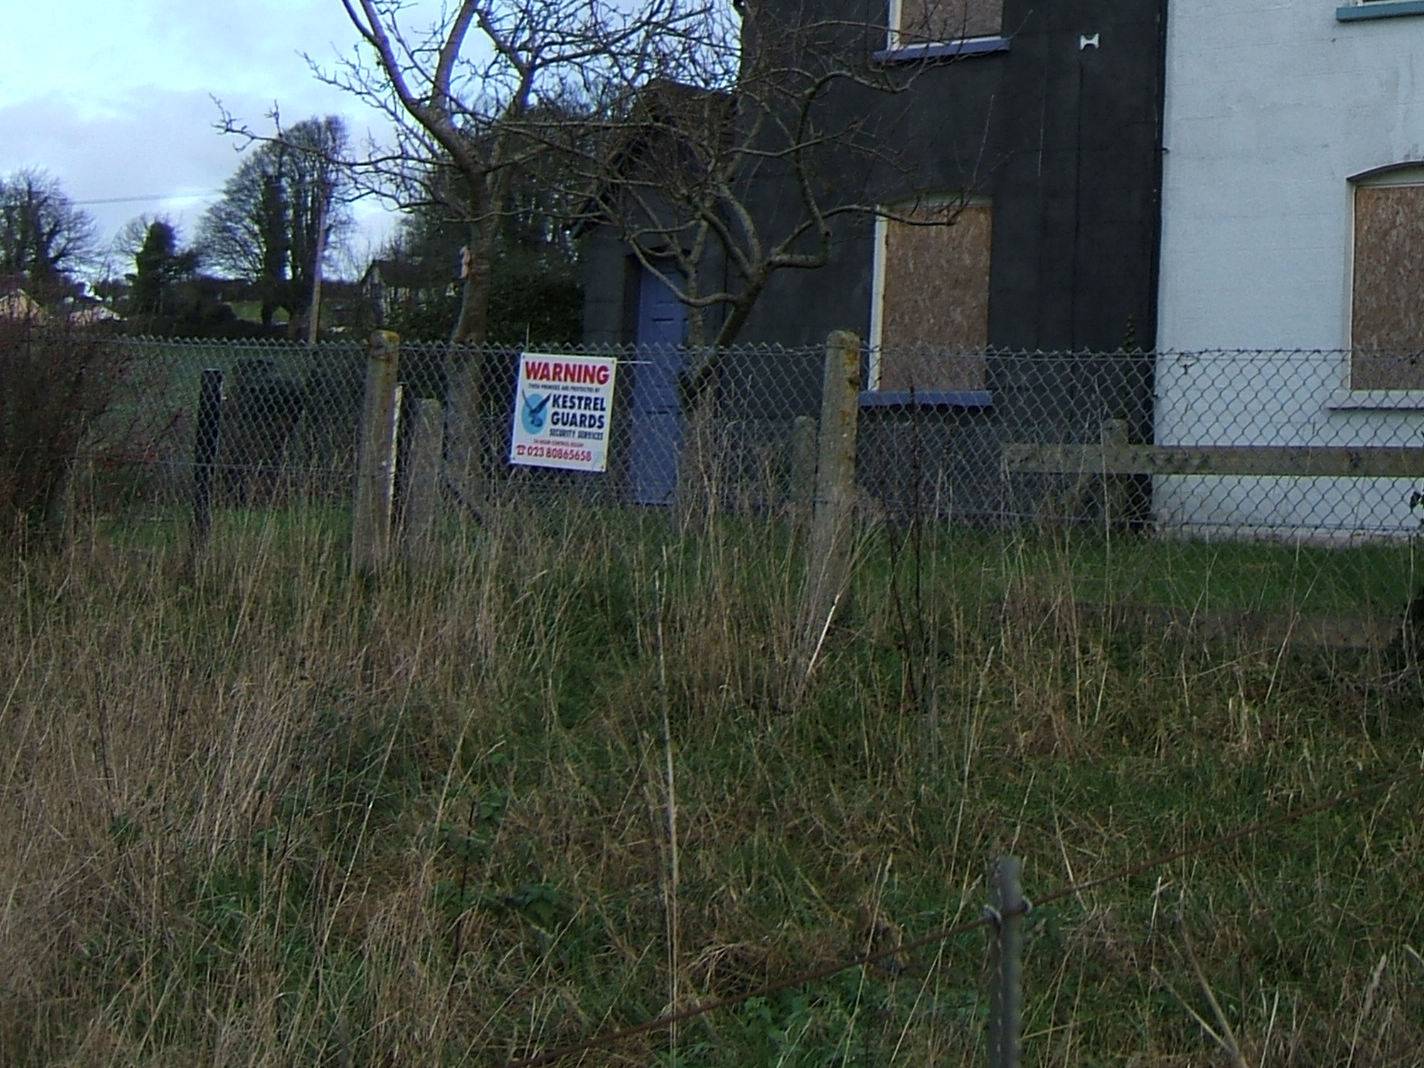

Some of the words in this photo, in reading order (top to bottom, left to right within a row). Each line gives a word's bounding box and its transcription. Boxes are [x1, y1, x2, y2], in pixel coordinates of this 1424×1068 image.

[525, 361, 609, 385] WARNING
[552, 394, 606, 411] KESTREL
[551, 412, 605, 429] GUARDS
[549, 428, 576, 438] SECURITY
[577, 430, 604, 440] SERVICES
[527, 446, 544, 457] 023
[546, 447, 592, 461] 80865658
